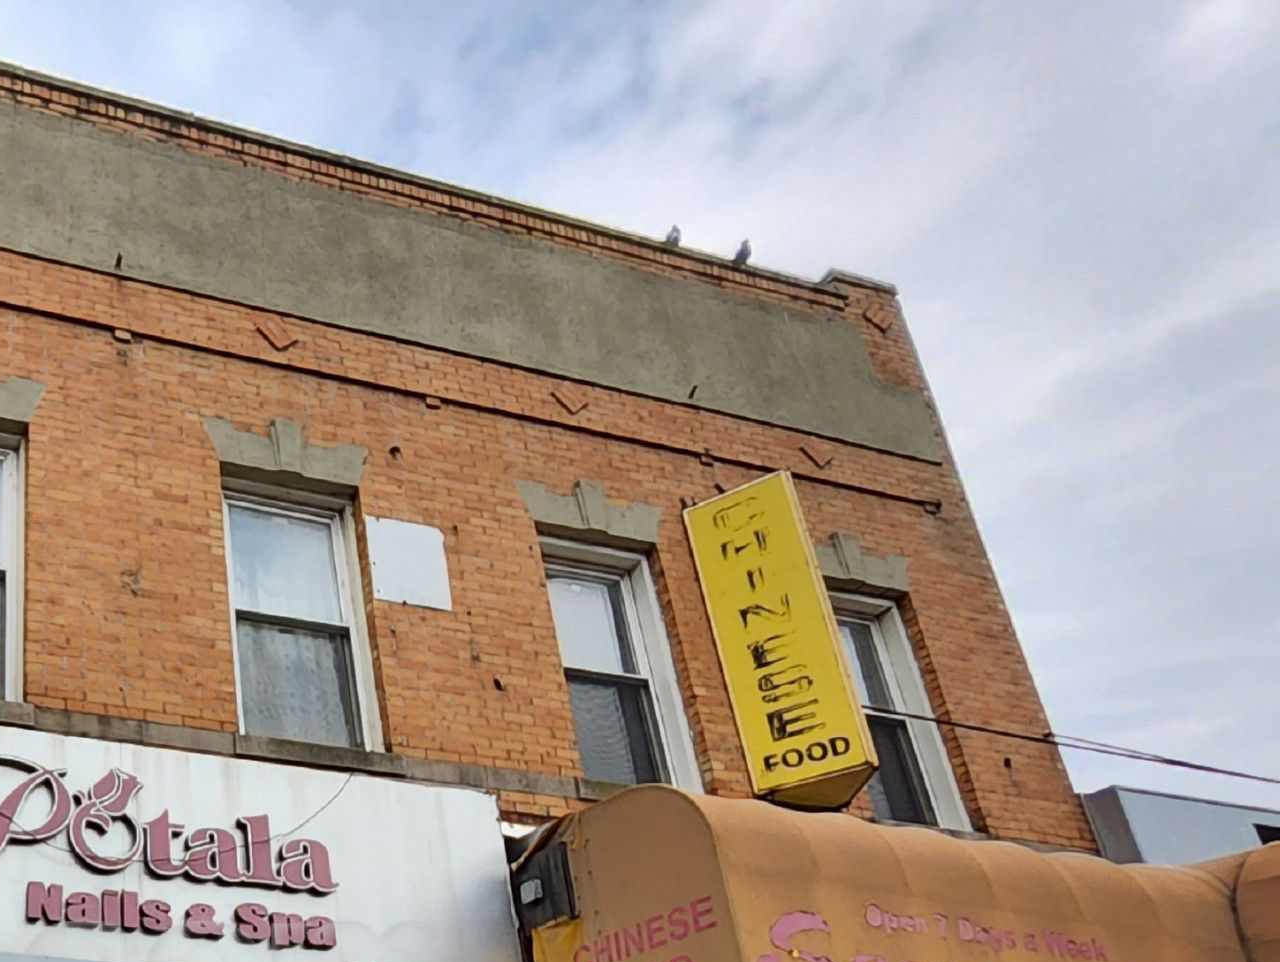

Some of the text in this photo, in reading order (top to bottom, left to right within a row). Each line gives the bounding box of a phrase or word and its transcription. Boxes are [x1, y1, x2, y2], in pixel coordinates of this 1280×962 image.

[763, 736, 851, 773] FOOD
[27, 881, 336, 950] Nails & Spa
[865, 903, 928, 935] Open
[958, 917, 1017, 952] Days
[1044, 930, 1109, 962] Week
